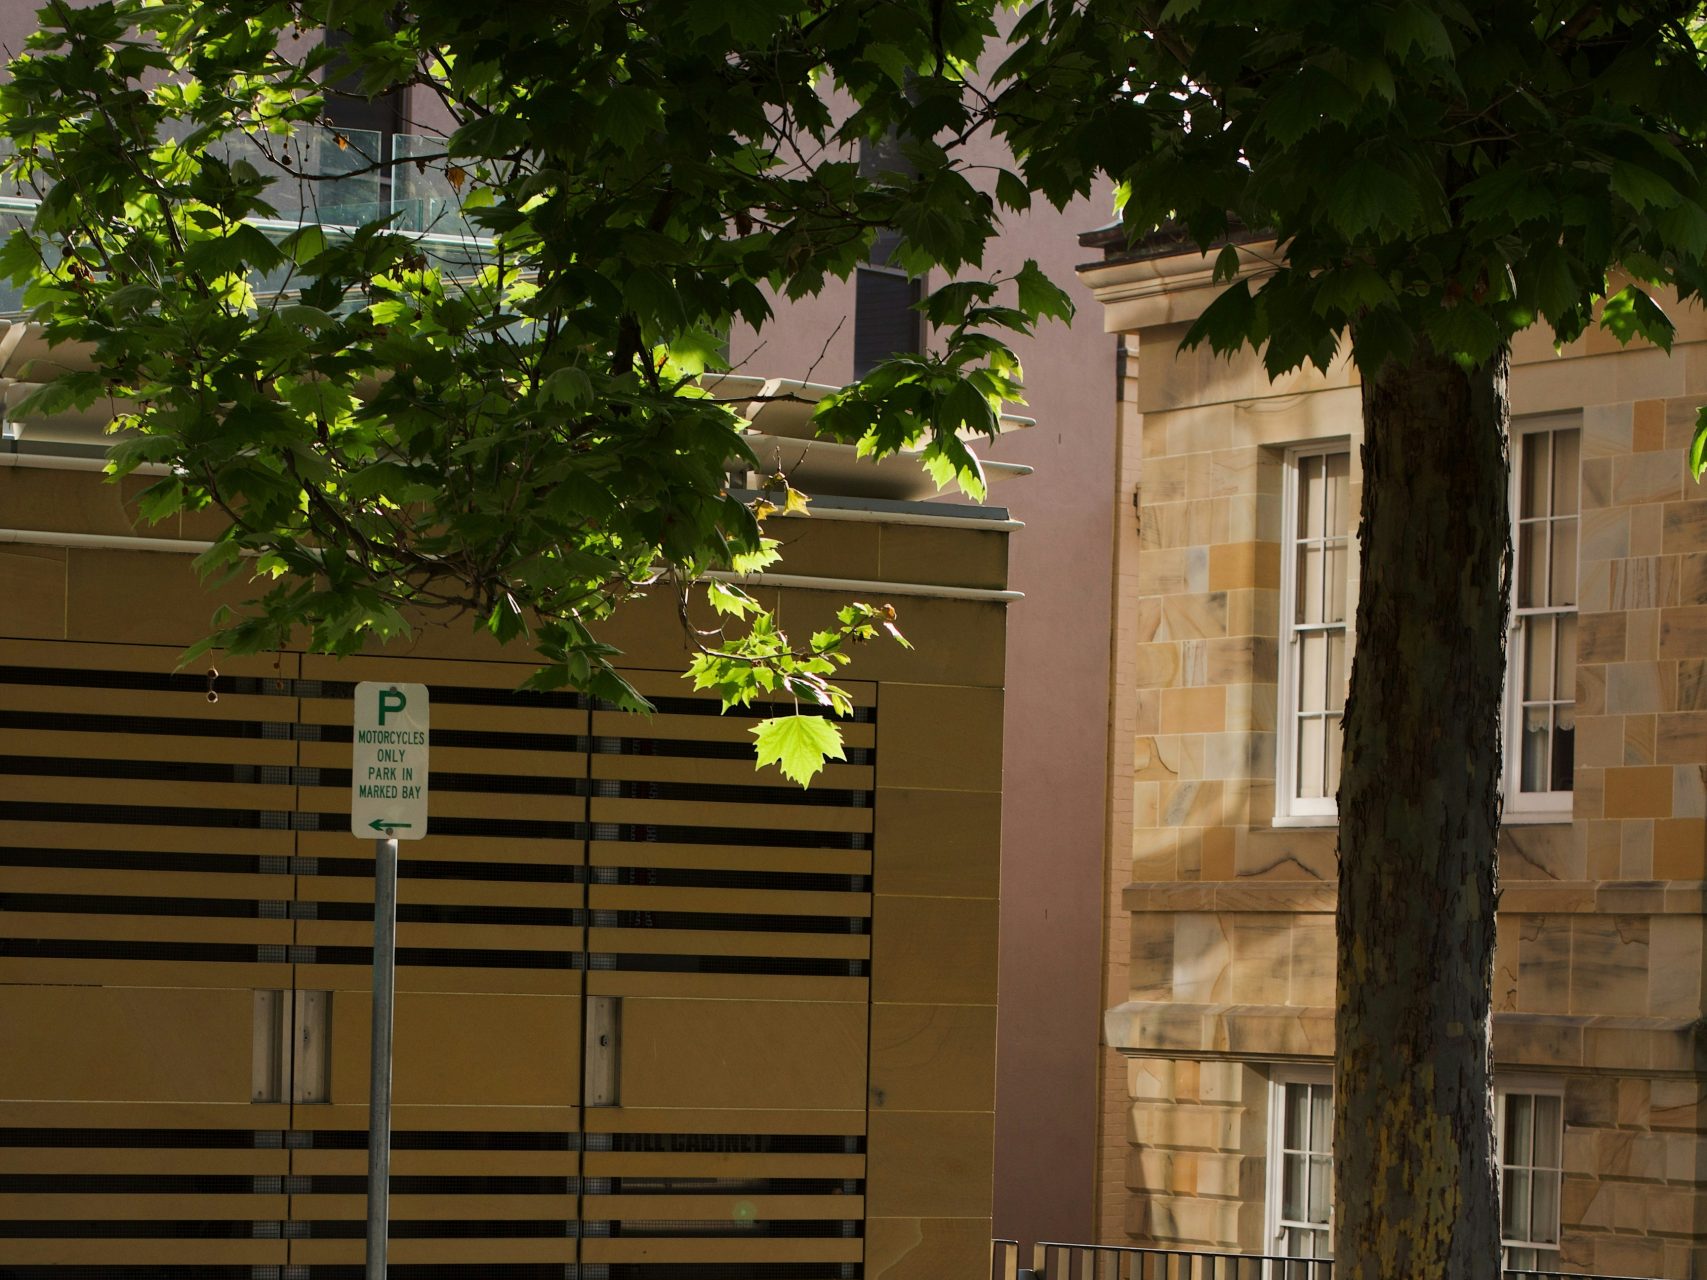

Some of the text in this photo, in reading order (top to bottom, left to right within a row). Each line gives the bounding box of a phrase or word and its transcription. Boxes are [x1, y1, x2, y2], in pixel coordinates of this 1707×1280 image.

[378, 690, 407, 726] P
[358, 730, 425, 745] MOTORCYCLES
[377, 748, 406, 763] ONLY
[368, 767, 413, 781] PARK IN
[359, 785, 421, 799] MARKED BAY
